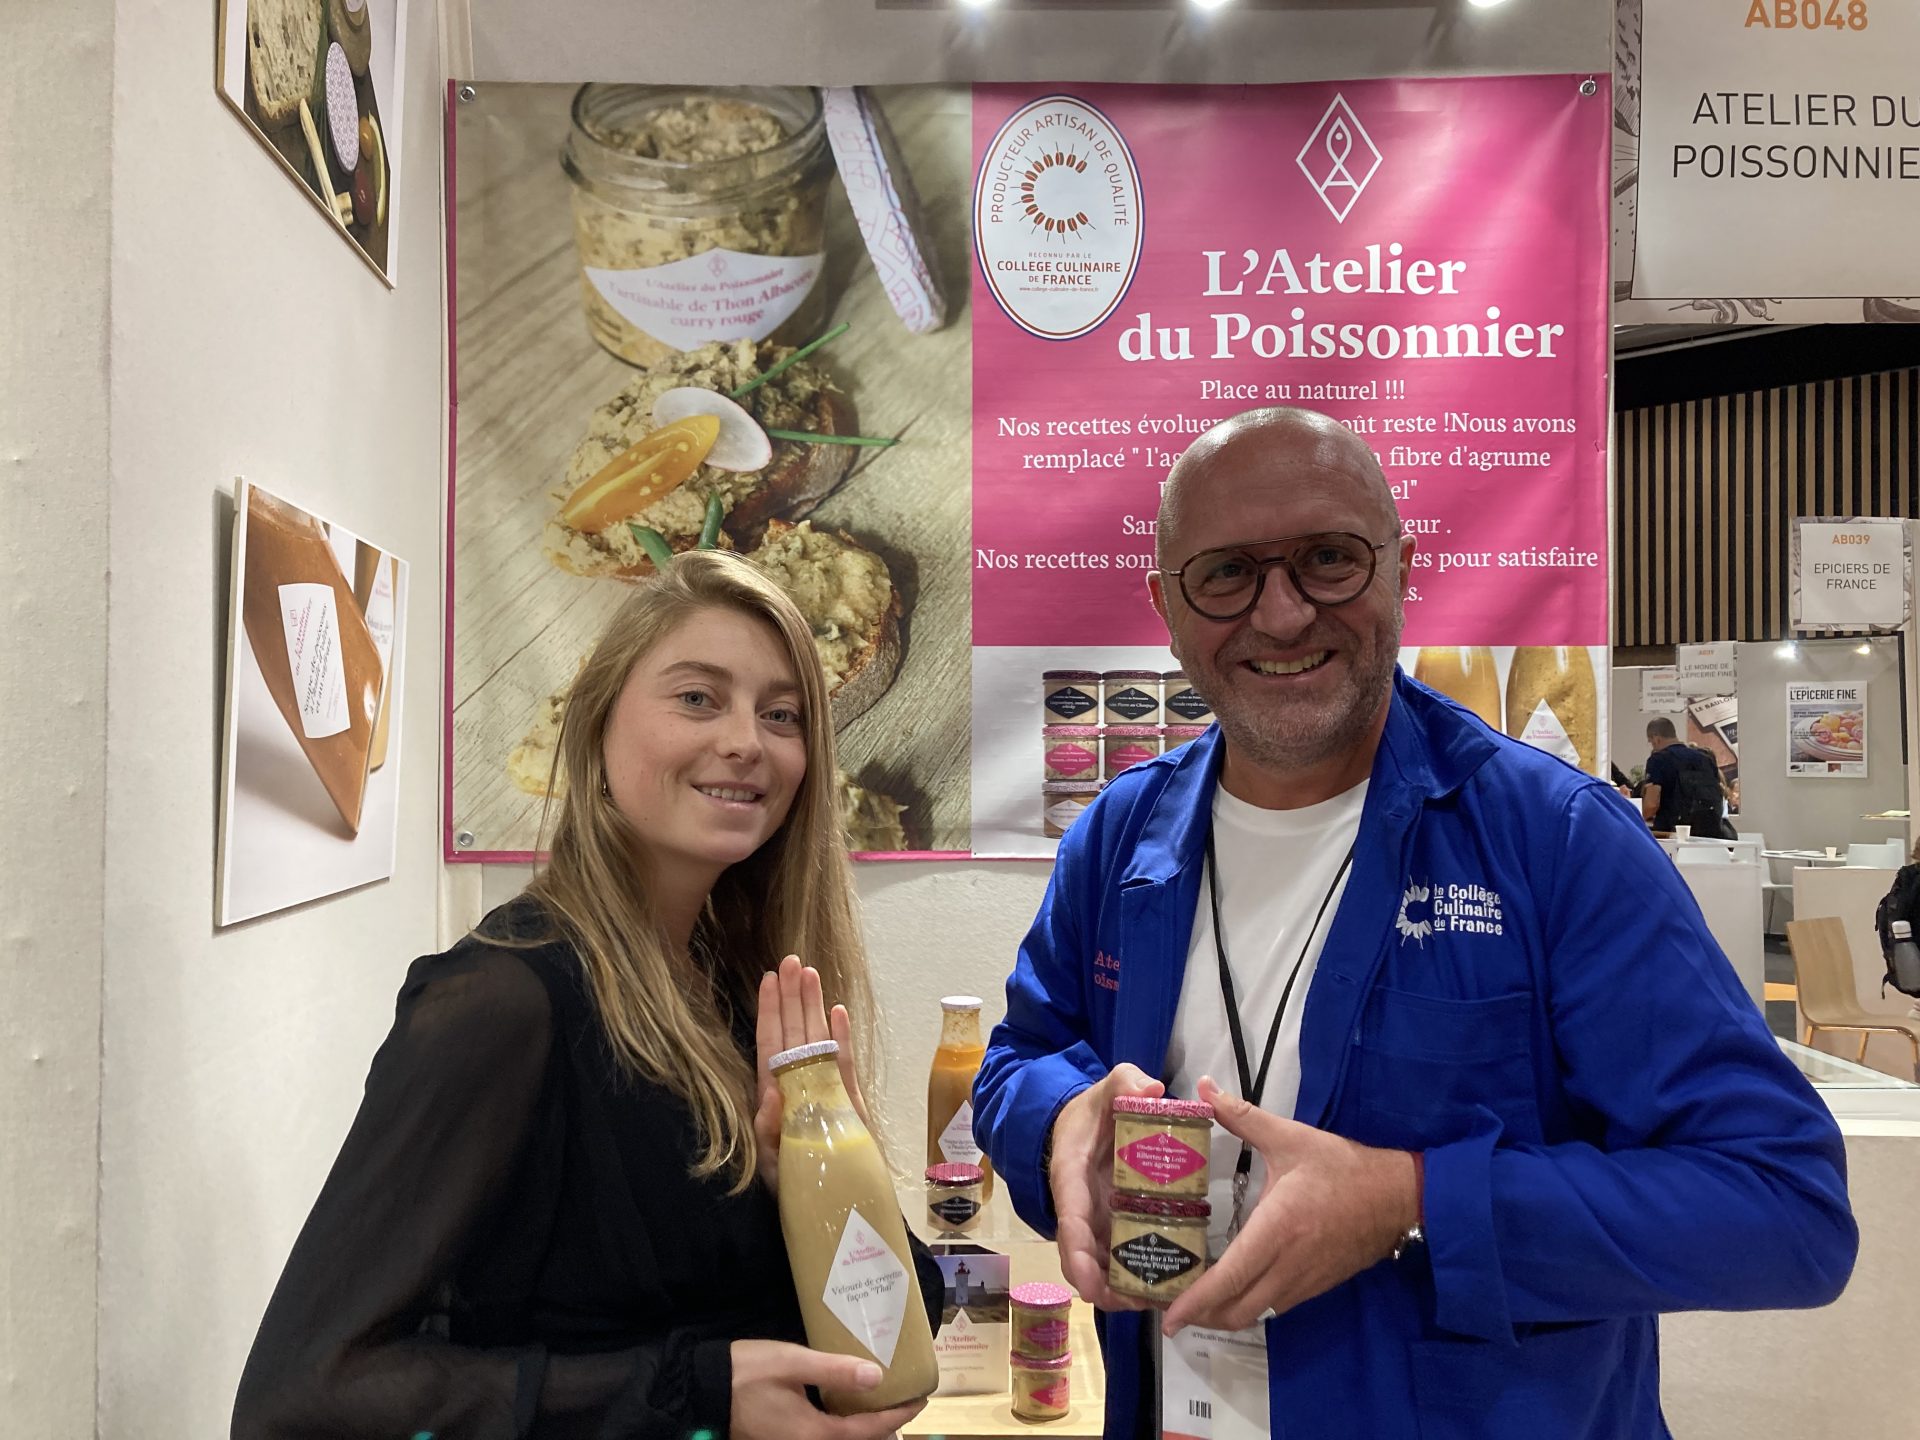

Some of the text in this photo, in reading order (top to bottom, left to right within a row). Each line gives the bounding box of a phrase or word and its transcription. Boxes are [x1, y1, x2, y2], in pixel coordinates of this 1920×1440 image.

[1745, 0, 1869, 31] AB048
[1693, 92, 1920, 127] ATELIER DU
[991, 113, 1130, 226] PRODUCTEUR ARTISAN DE QUALITÉ
[997, 260, 1121, 273] COLLEGE CULINAIRE
[1028, 274, 1092, 285] DE FRANCE
[688, 300, 708, 313] de
[712, 297, 755, 312] Thon
[670, 308, 765, 330] curry rouge
[1118, 307, 1565, 362] du Poissonnier
[1200, 379, 1406, 401] Place au naturel !!!
[997, 417, 1041, 437] Nos
[1046, 418, 1132, 436] recettes
[1383, 415, 1437, 433] reste
[1512, 416, 1577, 433] avons
[1023, 448, 1126, 474] remplacé
[1389, 446, 1442, 466] fibre
[1449, 446, 1551, 473] d'agrume
[1831, 533, 1871, 545] AB039
[976, 549, 1019, 569] Nos
[1025, 551, 1110, 569] recettes
[1438, 551, 1492, 573] pour
[1498, 546, 1599, 568] satisfaire
[1814, 562, 1891, 575] EPICIERS DE
[1826, 578, 1877, 591] FRANCE
[1837, 688, 1857, 700] FINE
[1434, 884, 1501, 907] le Collège
[1434, 899, 1503, 919] Culinaire
[1434, 916, 1503, 936] de France
[831, 1280, 862, 1297] Velouté
[864, 1276, 875, 1287] de
[846, 1290, 869, 1304] façon
